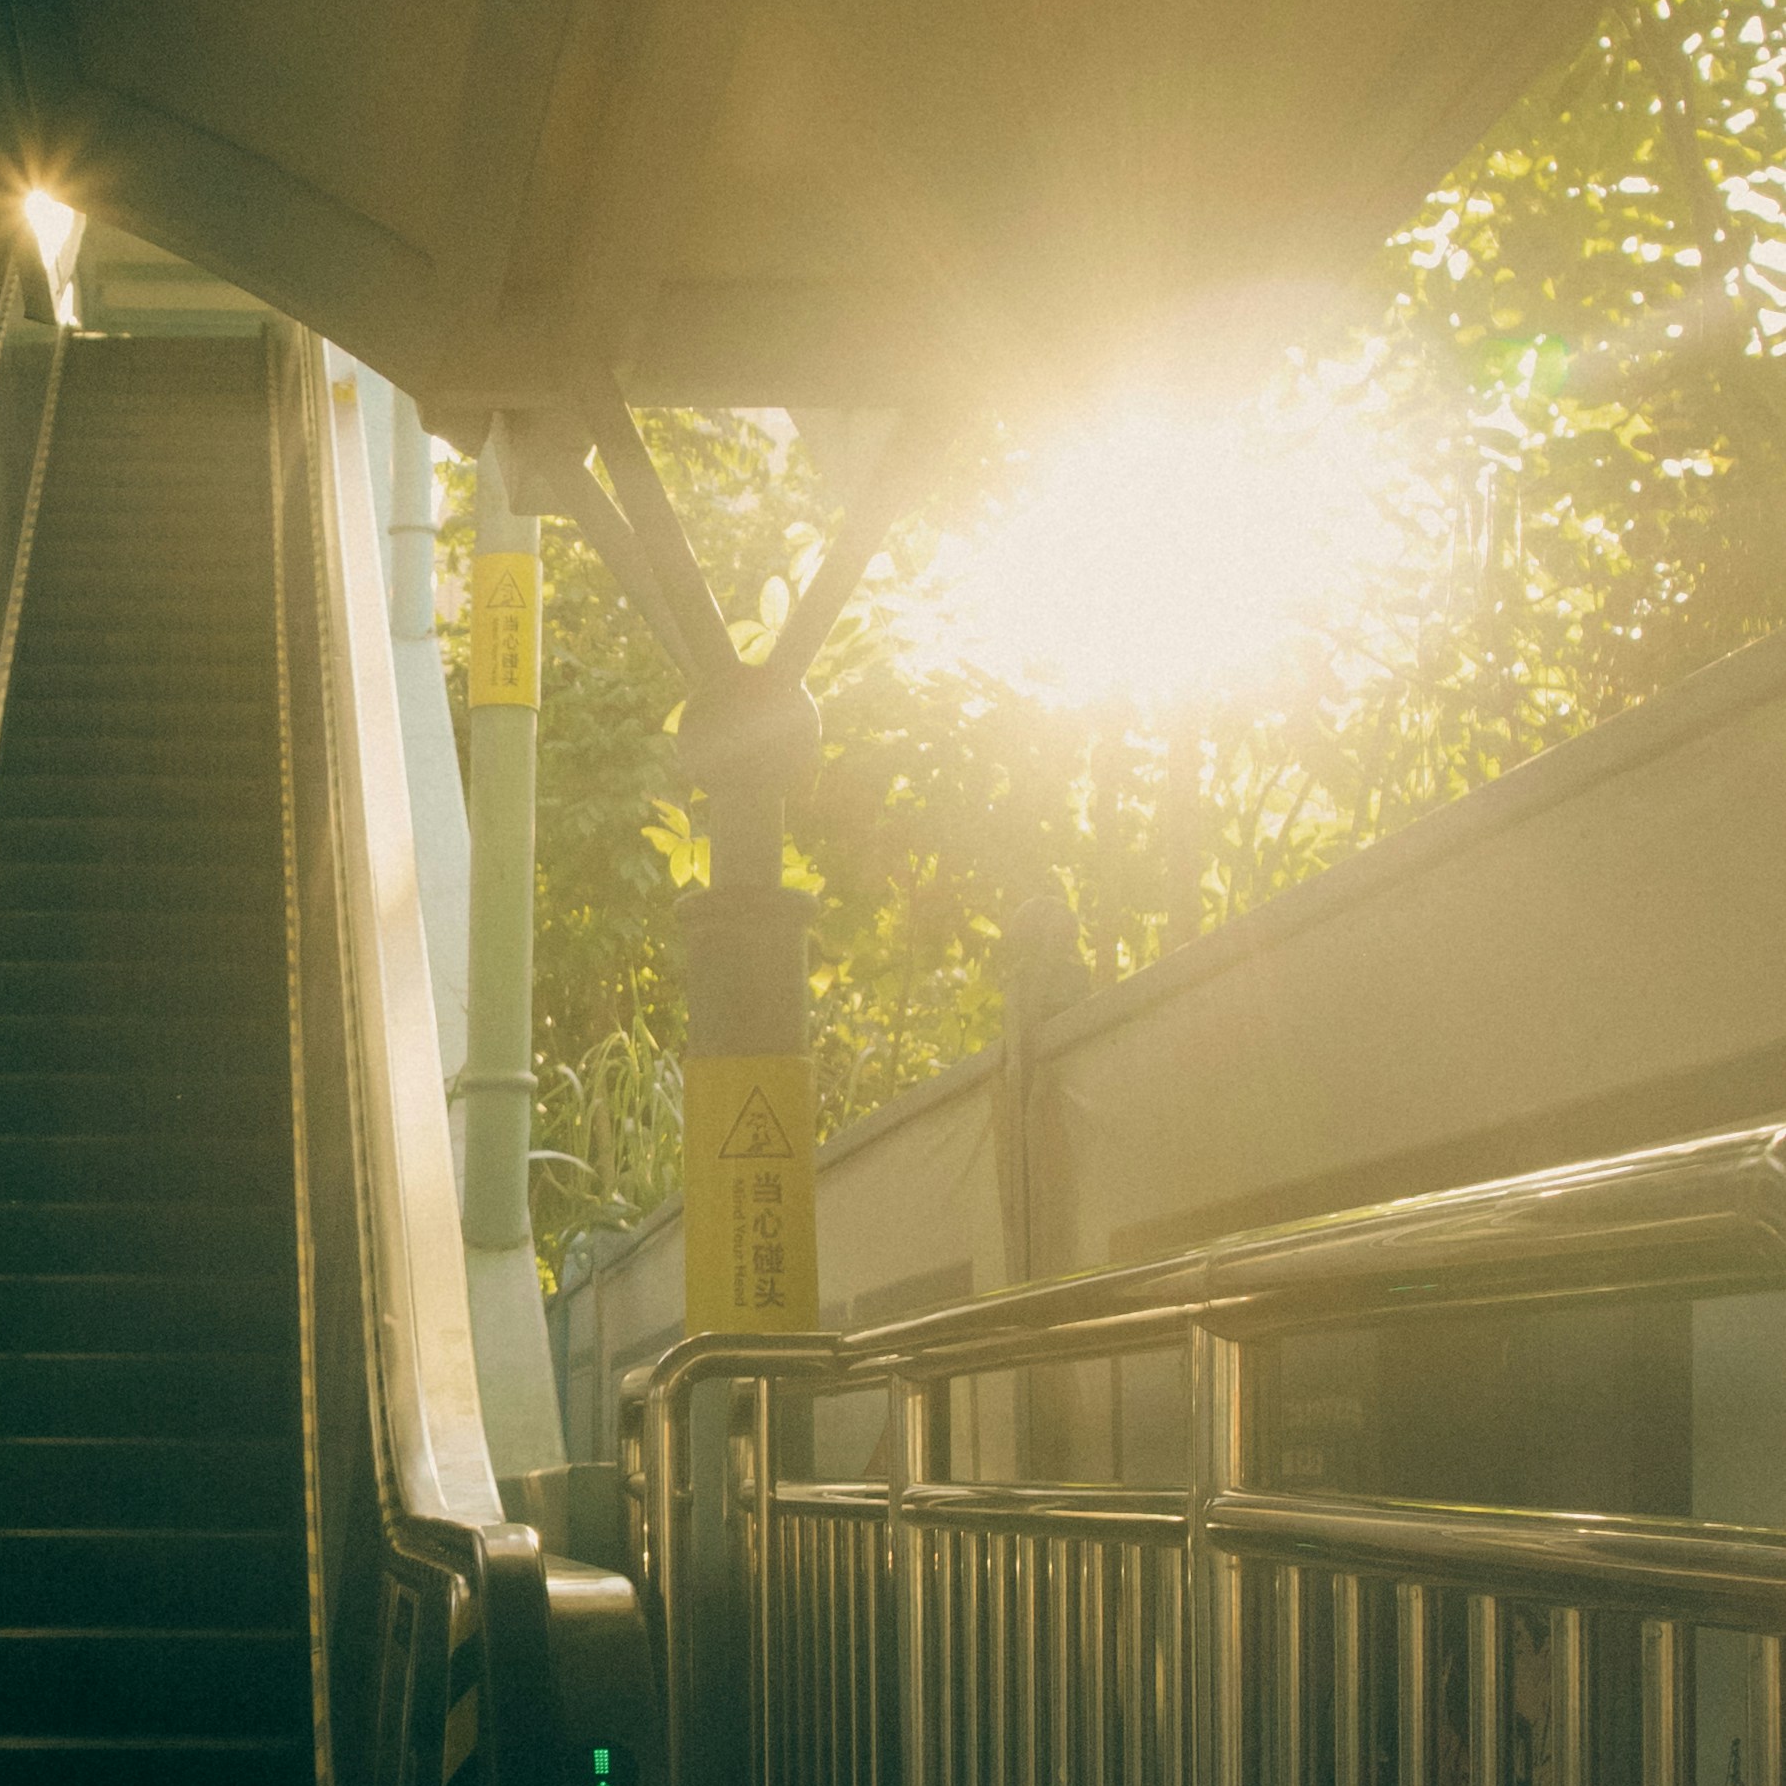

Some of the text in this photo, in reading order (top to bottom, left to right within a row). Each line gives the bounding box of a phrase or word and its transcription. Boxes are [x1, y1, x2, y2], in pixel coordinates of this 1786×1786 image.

[733, 1179, 748, 1307] Mind Your Head
[752, 1171, 785, 1309] 当心碰头
